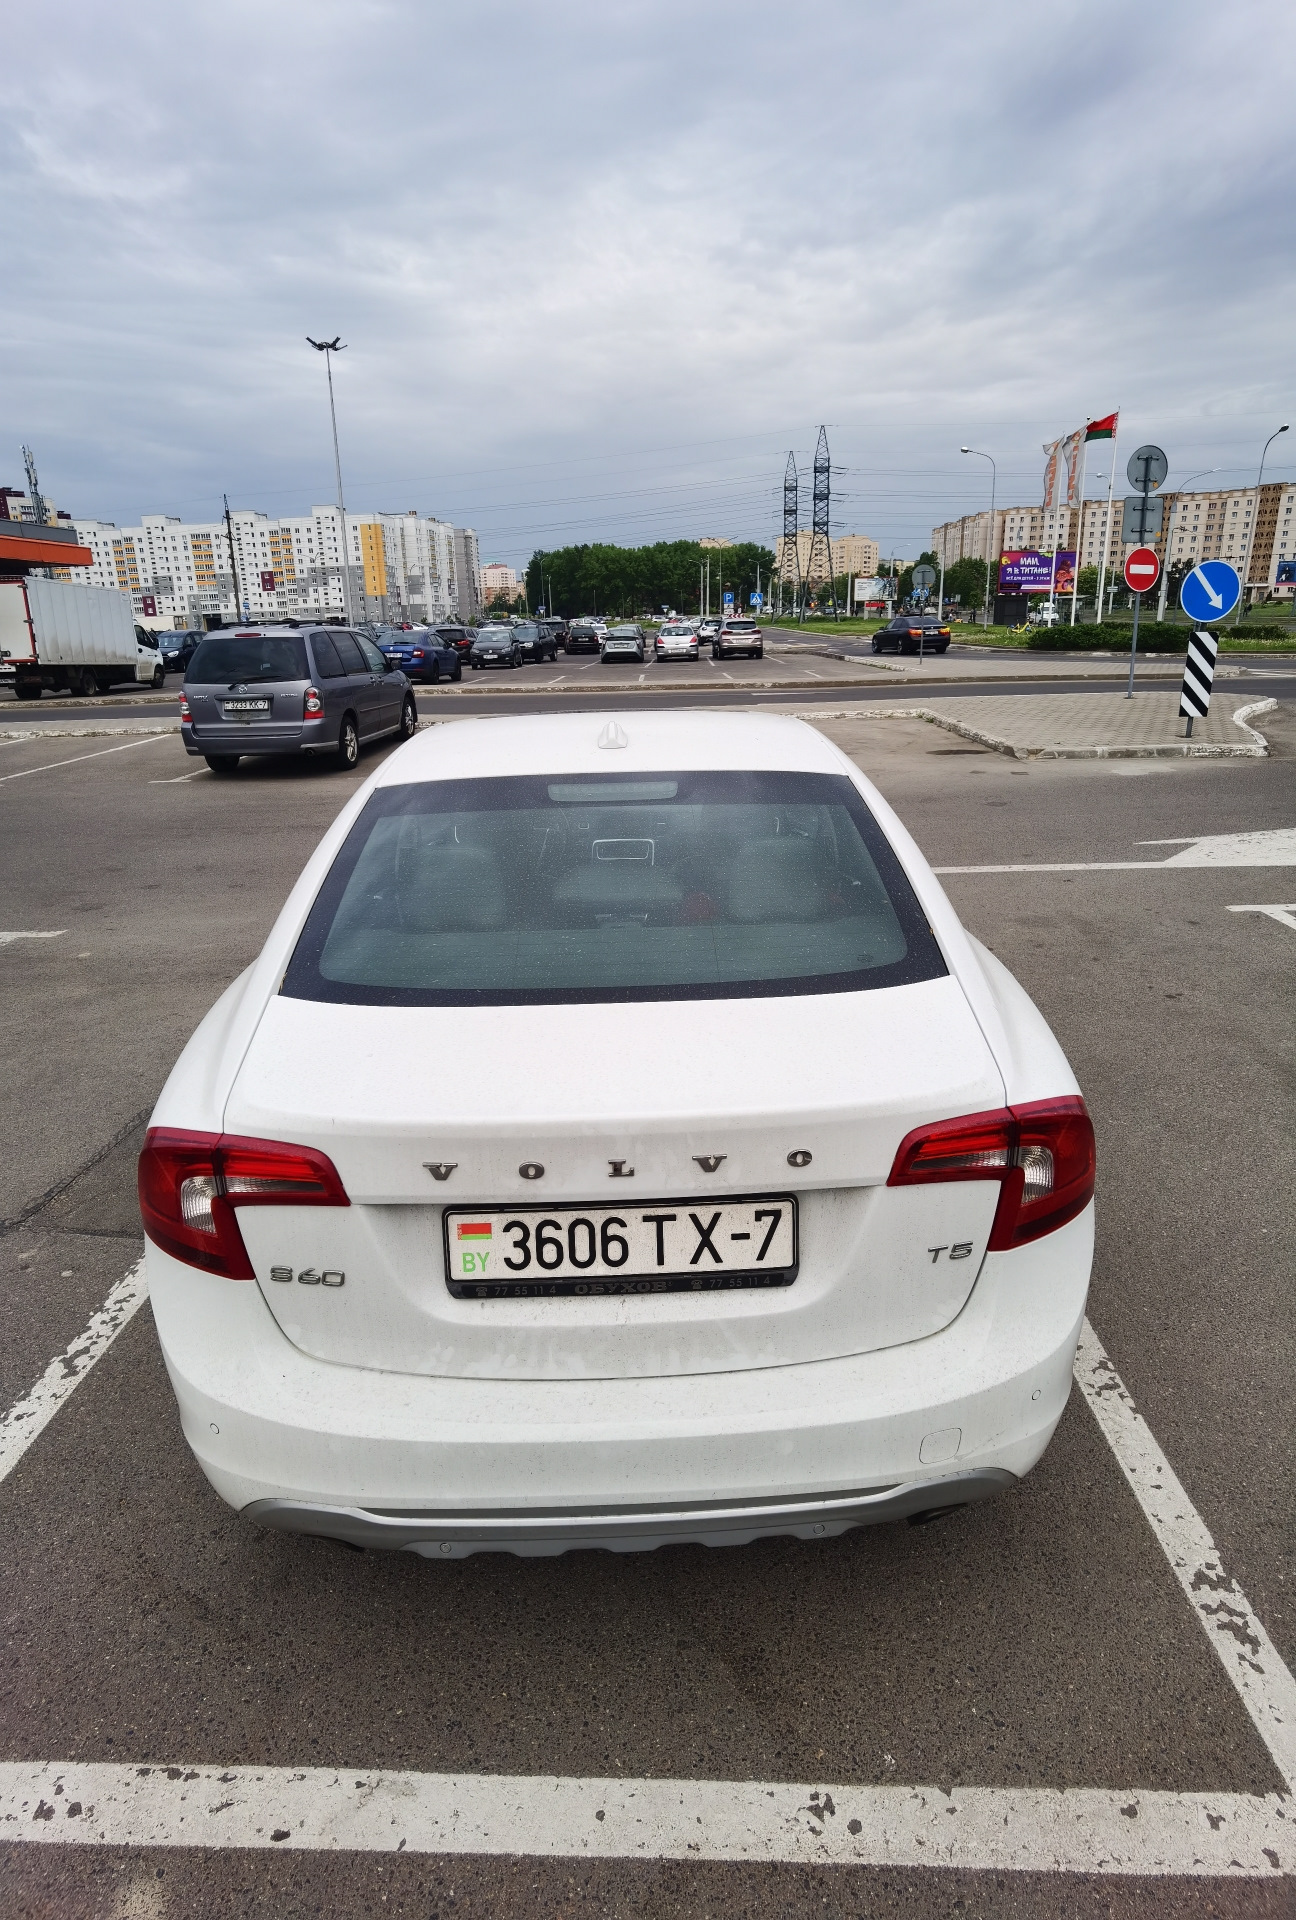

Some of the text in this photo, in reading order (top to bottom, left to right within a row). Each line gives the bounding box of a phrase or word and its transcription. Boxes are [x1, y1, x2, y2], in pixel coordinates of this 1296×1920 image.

[726, 593, 732, 602] P
[422, 1148, 813, 1181] VOLVO
[502, 1216, 629, 1271] 3606
[927, 1240, 974, 1264] T5
[461, 1251, 491, 1273] BY
[269, 1264, 346, 1287] S60
[494, 1276, 771, 1296] 77 55 11 4 ОБУХОВ 77 55 11 4
